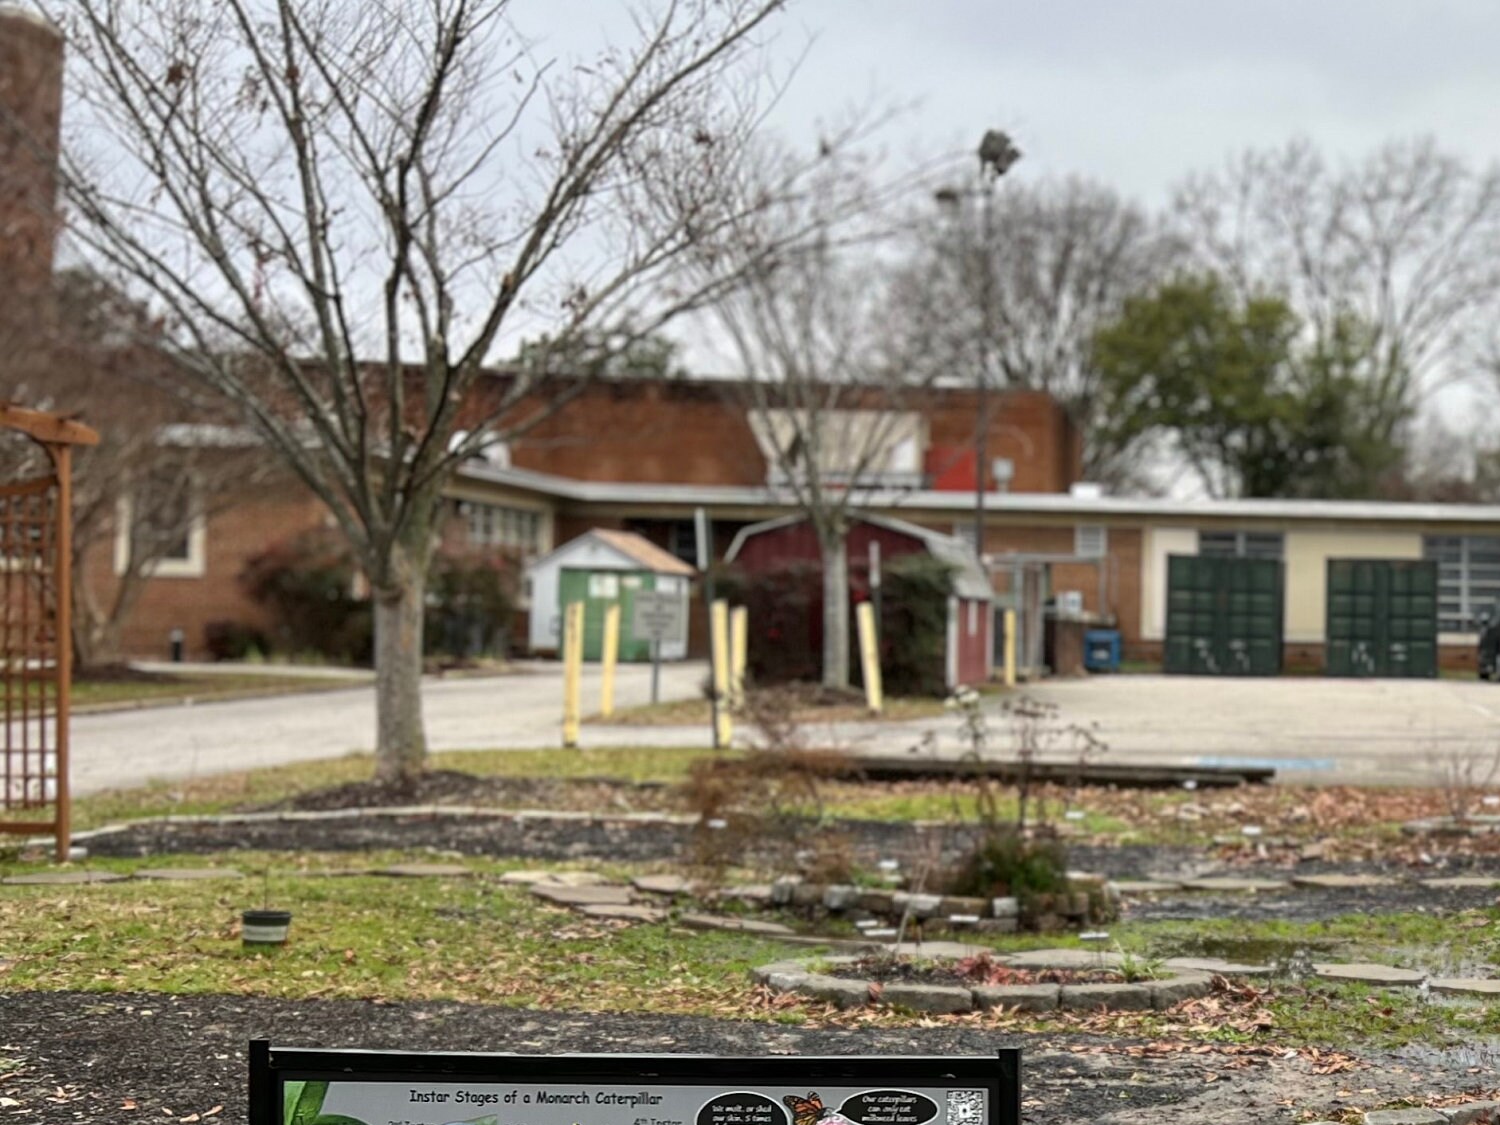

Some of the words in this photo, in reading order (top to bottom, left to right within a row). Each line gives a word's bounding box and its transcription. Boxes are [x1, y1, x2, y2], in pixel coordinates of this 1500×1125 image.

[409, 1090, 450, 1103] Instar
[455, 1090, 499, 1106] Stages
[504, 1090, 517, 1104] of
[523, 1094, 531, 1104] a
[536, 1091, 590, 1104] Monarch
[595, 1092, 663, 1108] Caterpillar
